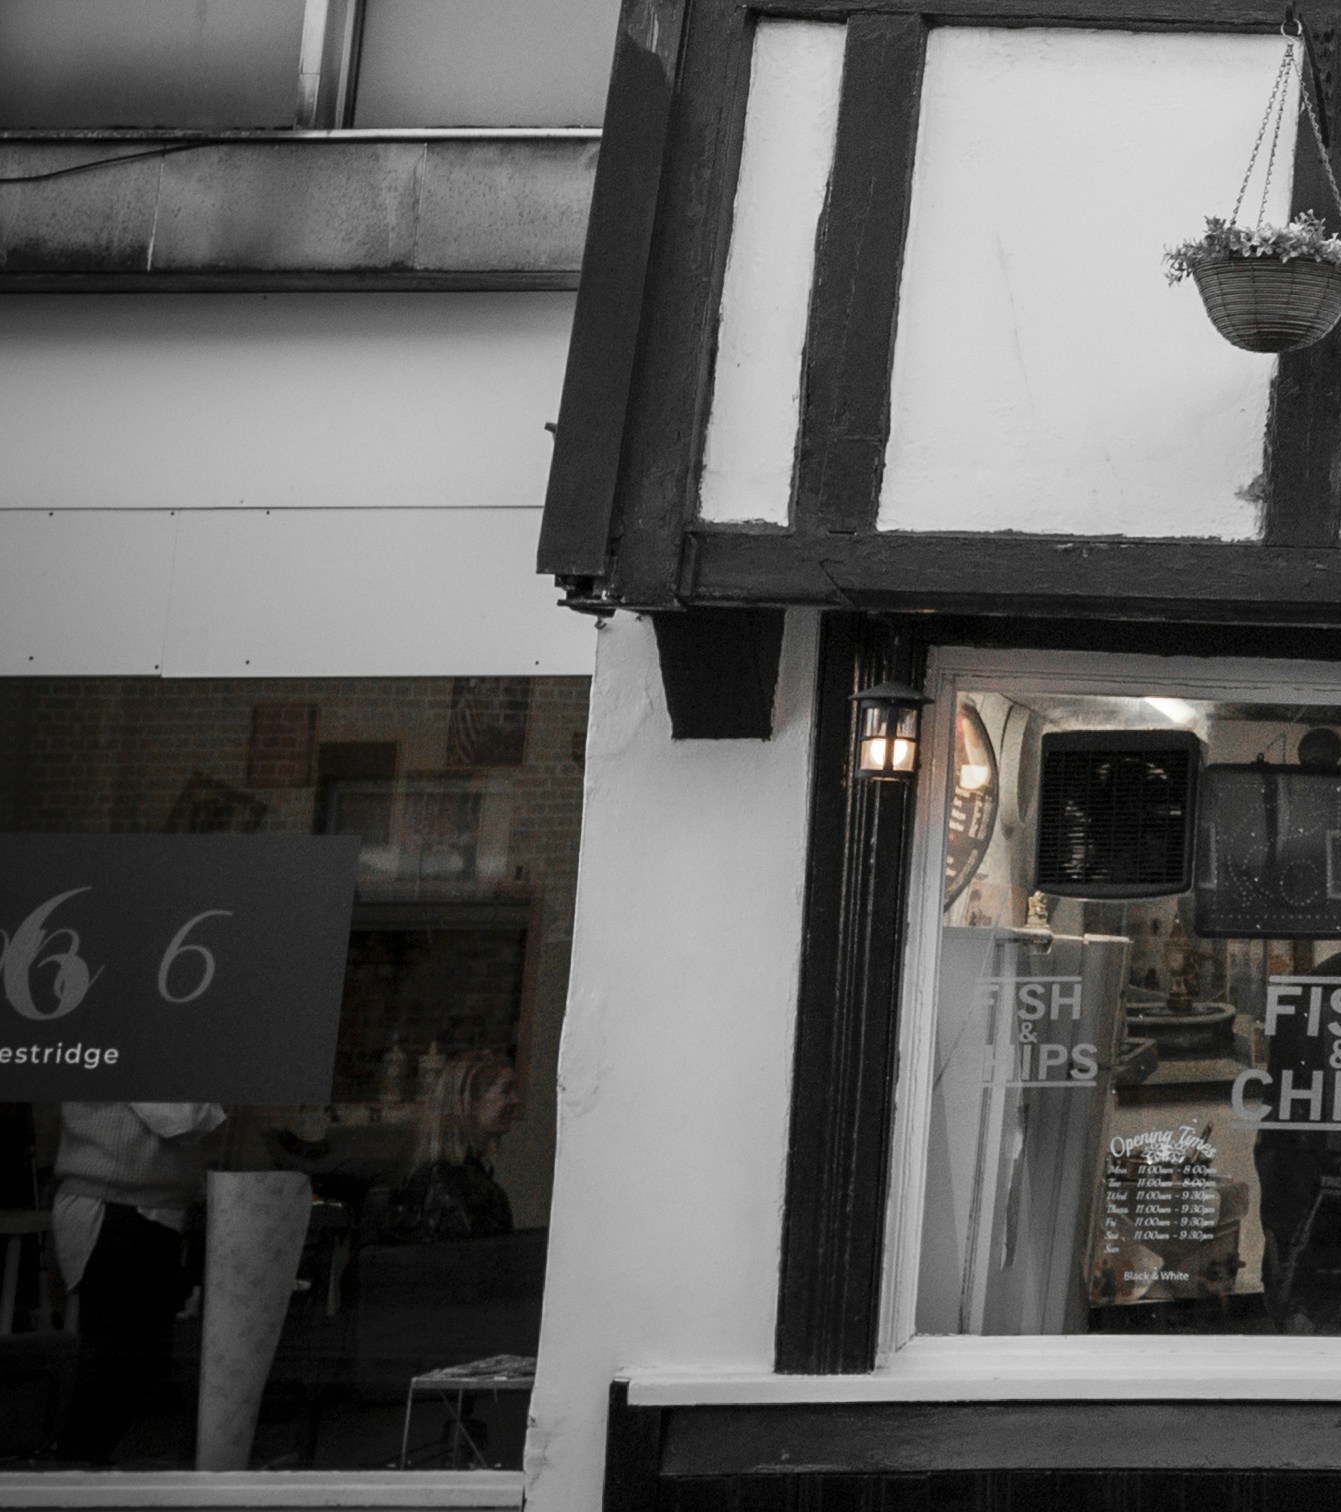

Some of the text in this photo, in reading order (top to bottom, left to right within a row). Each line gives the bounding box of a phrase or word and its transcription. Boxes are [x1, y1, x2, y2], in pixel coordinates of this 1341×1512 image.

[157, 909, 234, 1004] 6
[1018, 1021, 1039, 1044] &
[1110, 1125, 1218, 1158] Opening Times
[1123, 1271, 1190, 1282] Black & White
